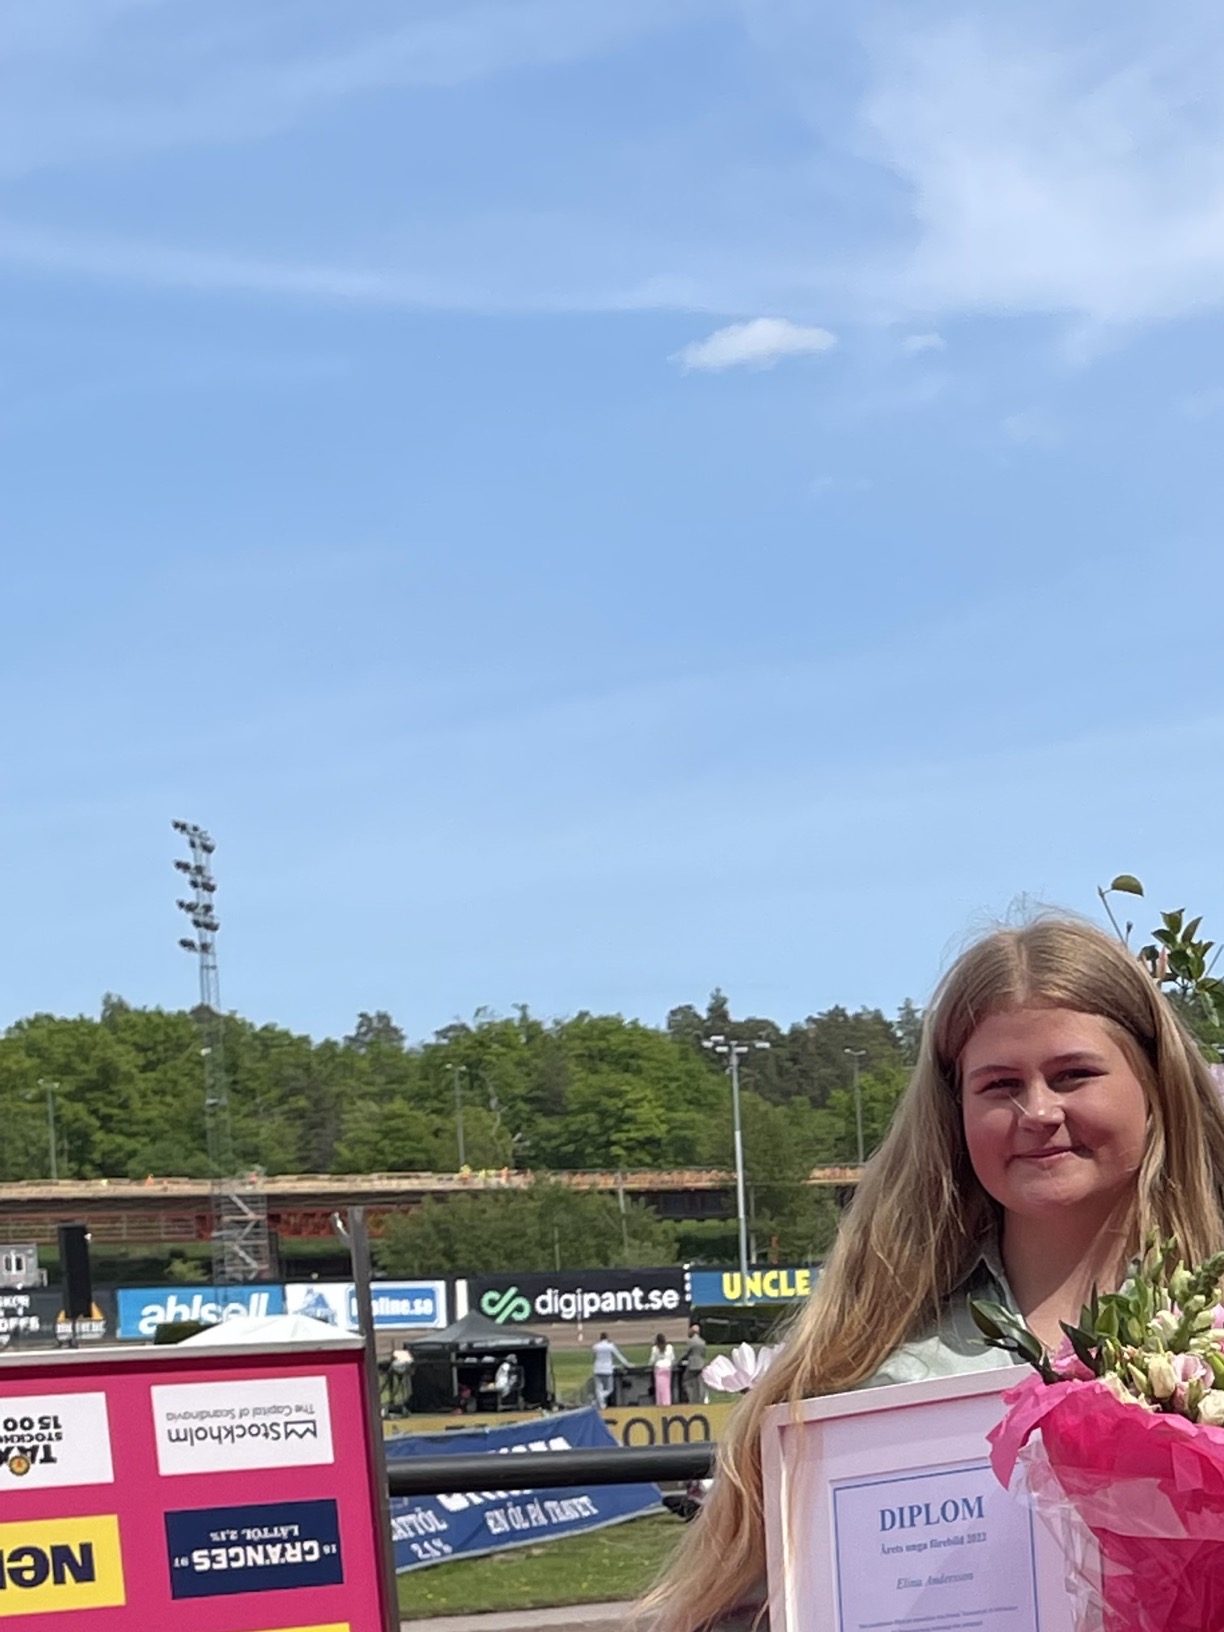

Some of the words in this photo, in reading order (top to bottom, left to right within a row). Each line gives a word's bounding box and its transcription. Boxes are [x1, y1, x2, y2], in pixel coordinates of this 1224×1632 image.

[722, 1269, 812, 1300] UNCLE
[534, 1286, 680, 1320] digipant.se
[165, 1408, 237, 1422] Scandinavia
[238, 1409, 250, 1420] of
[252, 1405, 293, 1418] Capital
[294, 1404, 316, 1416] The
[167, 1421, 281, 1447] Stockholm
[879, 1495, 985, 1532] DIPLOM
[191, 1539, 321, 1572] GRÄNGES
